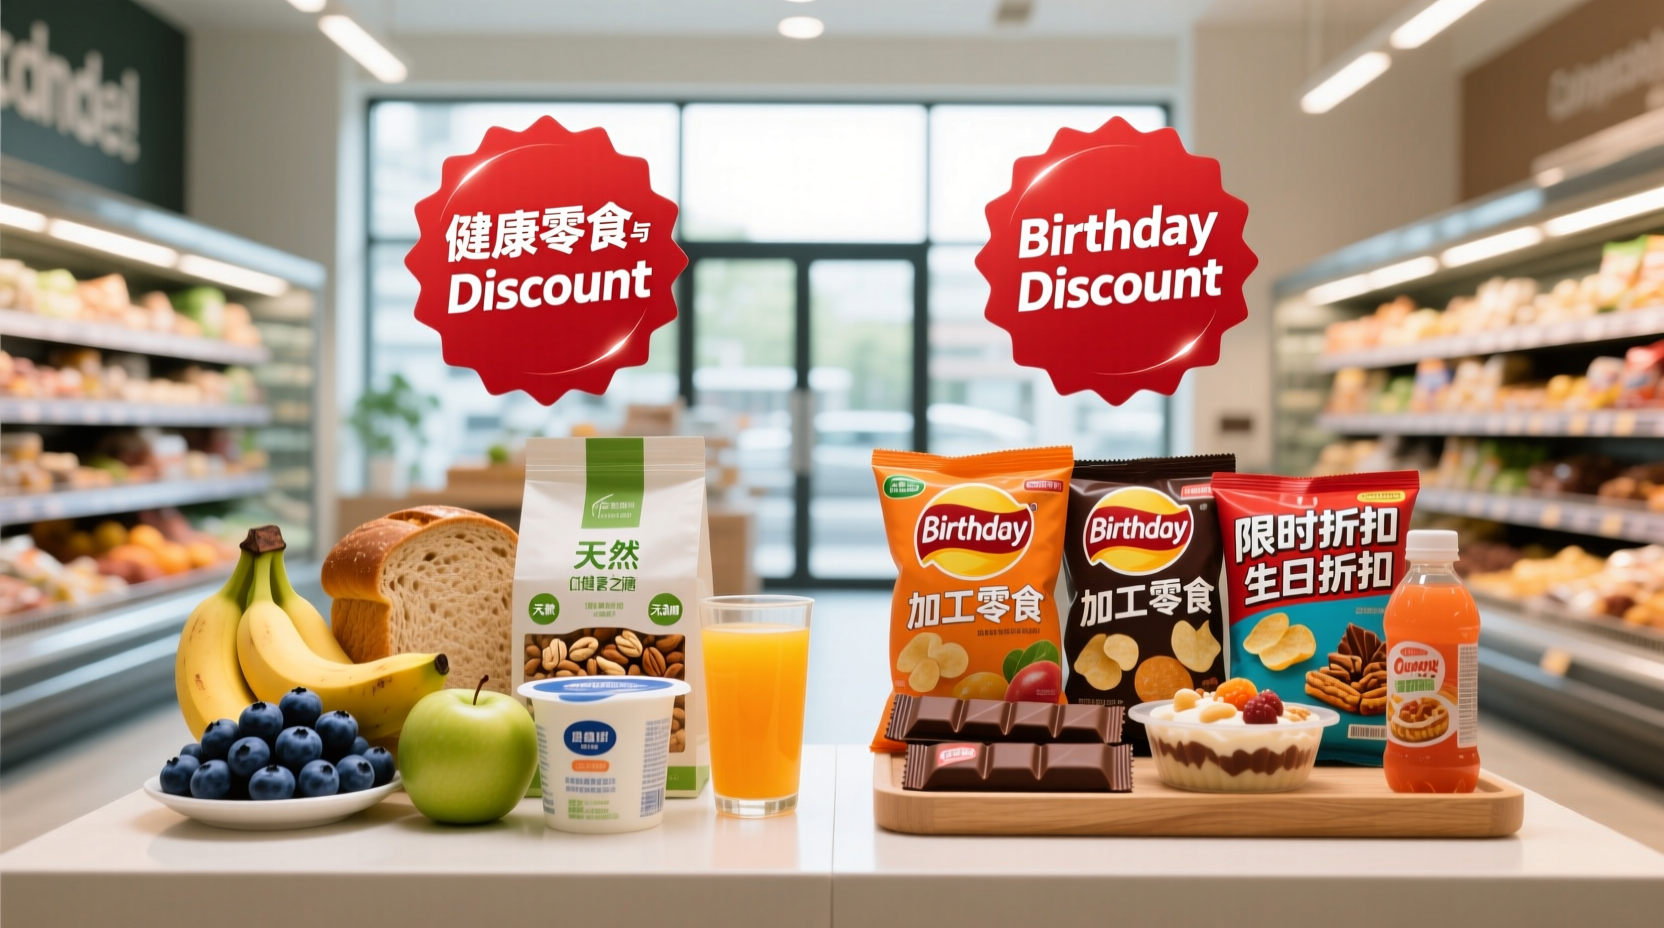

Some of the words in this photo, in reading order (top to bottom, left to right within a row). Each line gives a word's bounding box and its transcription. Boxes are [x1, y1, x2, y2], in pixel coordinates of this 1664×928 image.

[922, 515, 1028, 547] Birthday
[1090, 515, 1188, 545] Birthday
[1235, 506, 1398, 564] 限时折扣
[573, 539, 640, 570] 天然
[1244, 550, 1393, 606] 生日折扣
[906, 584, 1044, 630] 加工零食
[1080, 576, 1215, 627] 加工零食
